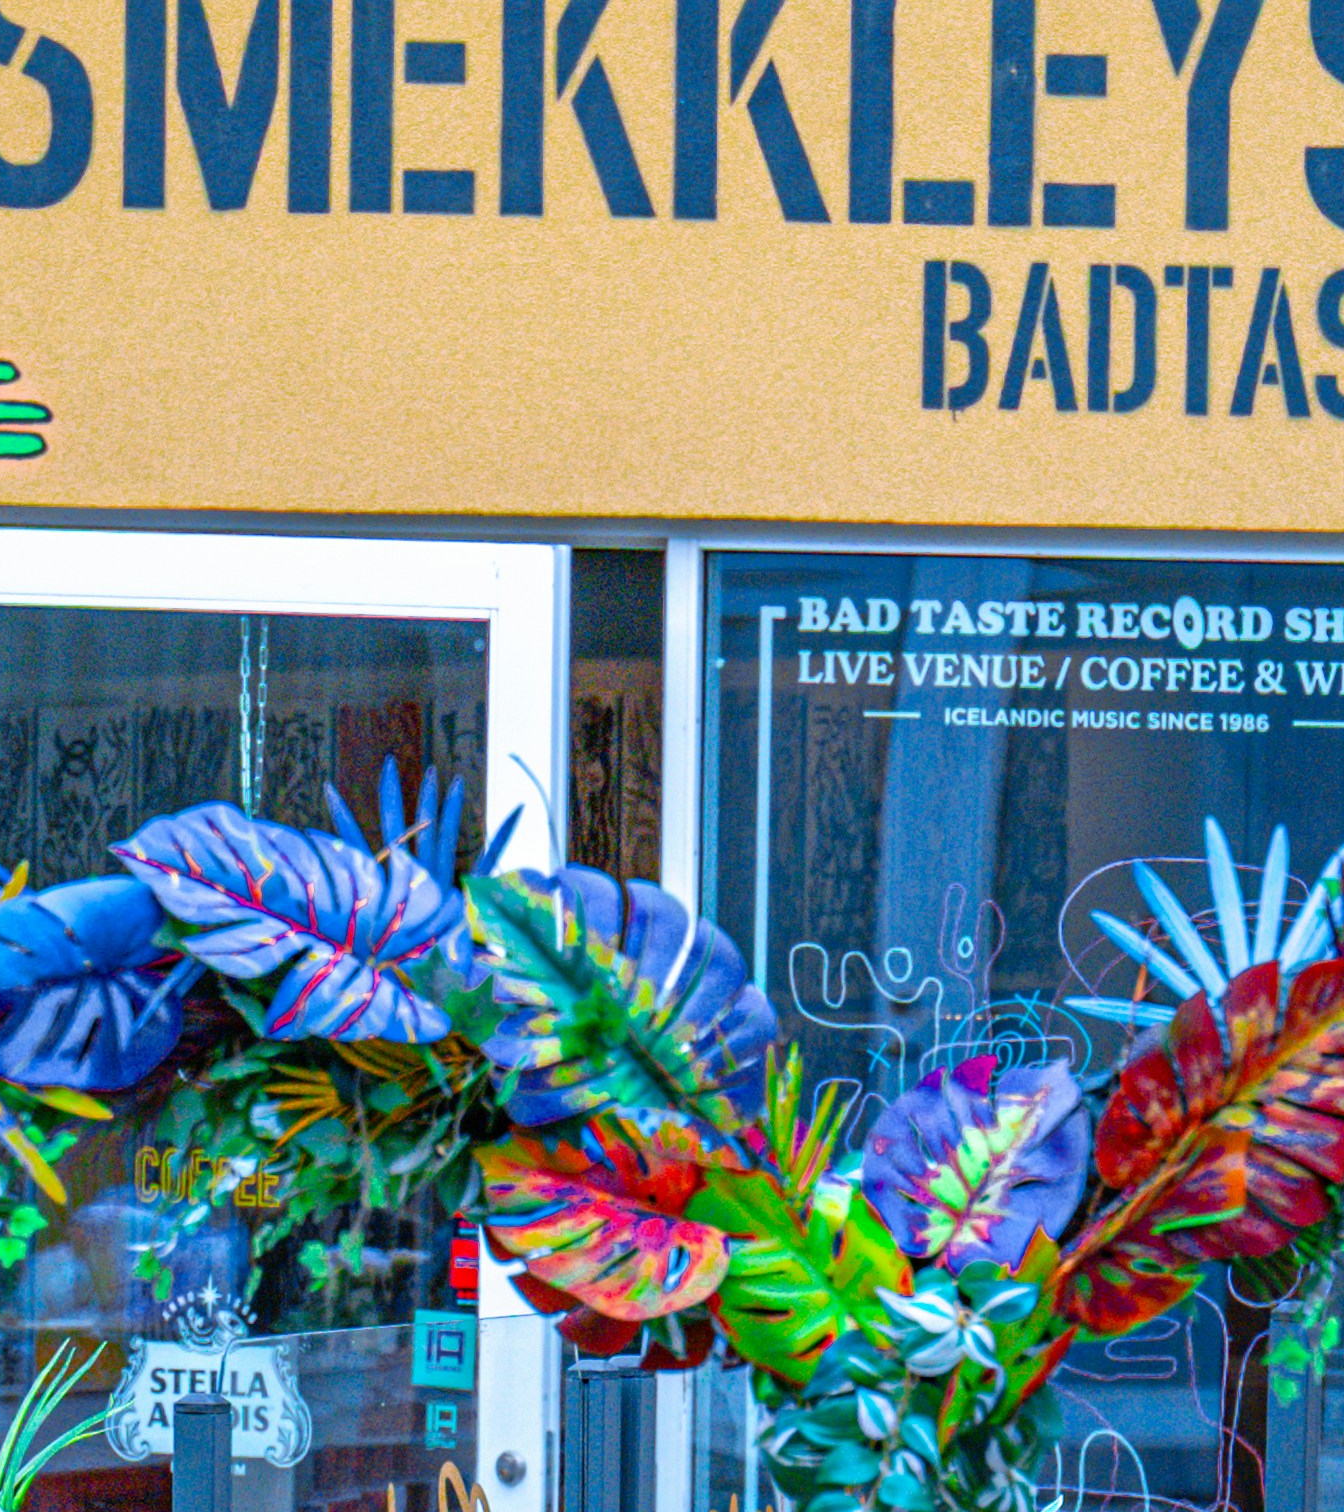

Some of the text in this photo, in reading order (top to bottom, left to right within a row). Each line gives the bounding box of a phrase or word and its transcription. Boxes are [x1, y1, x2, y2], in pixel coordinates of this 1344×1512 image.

[798, 596, 902, 634] BAD
[909, 599, 1067, 637] TASTE
[1075, 595, 1274, 650] RECORD
[797, 649, 896, 686] LIVE
[902, 652, 1048, 689] VENUE
[1054, 655, 1073, 691] /
[1080, 656, 1246, 694] COFFEE
[1253, 658, 1288, 695] &
[943, 706, 1271, 733] ICELANDIC MUSIC SINCE 1986
[149, 1367, 269, 1399] STELLA
[147, 1401, 270, 1433] AIS
